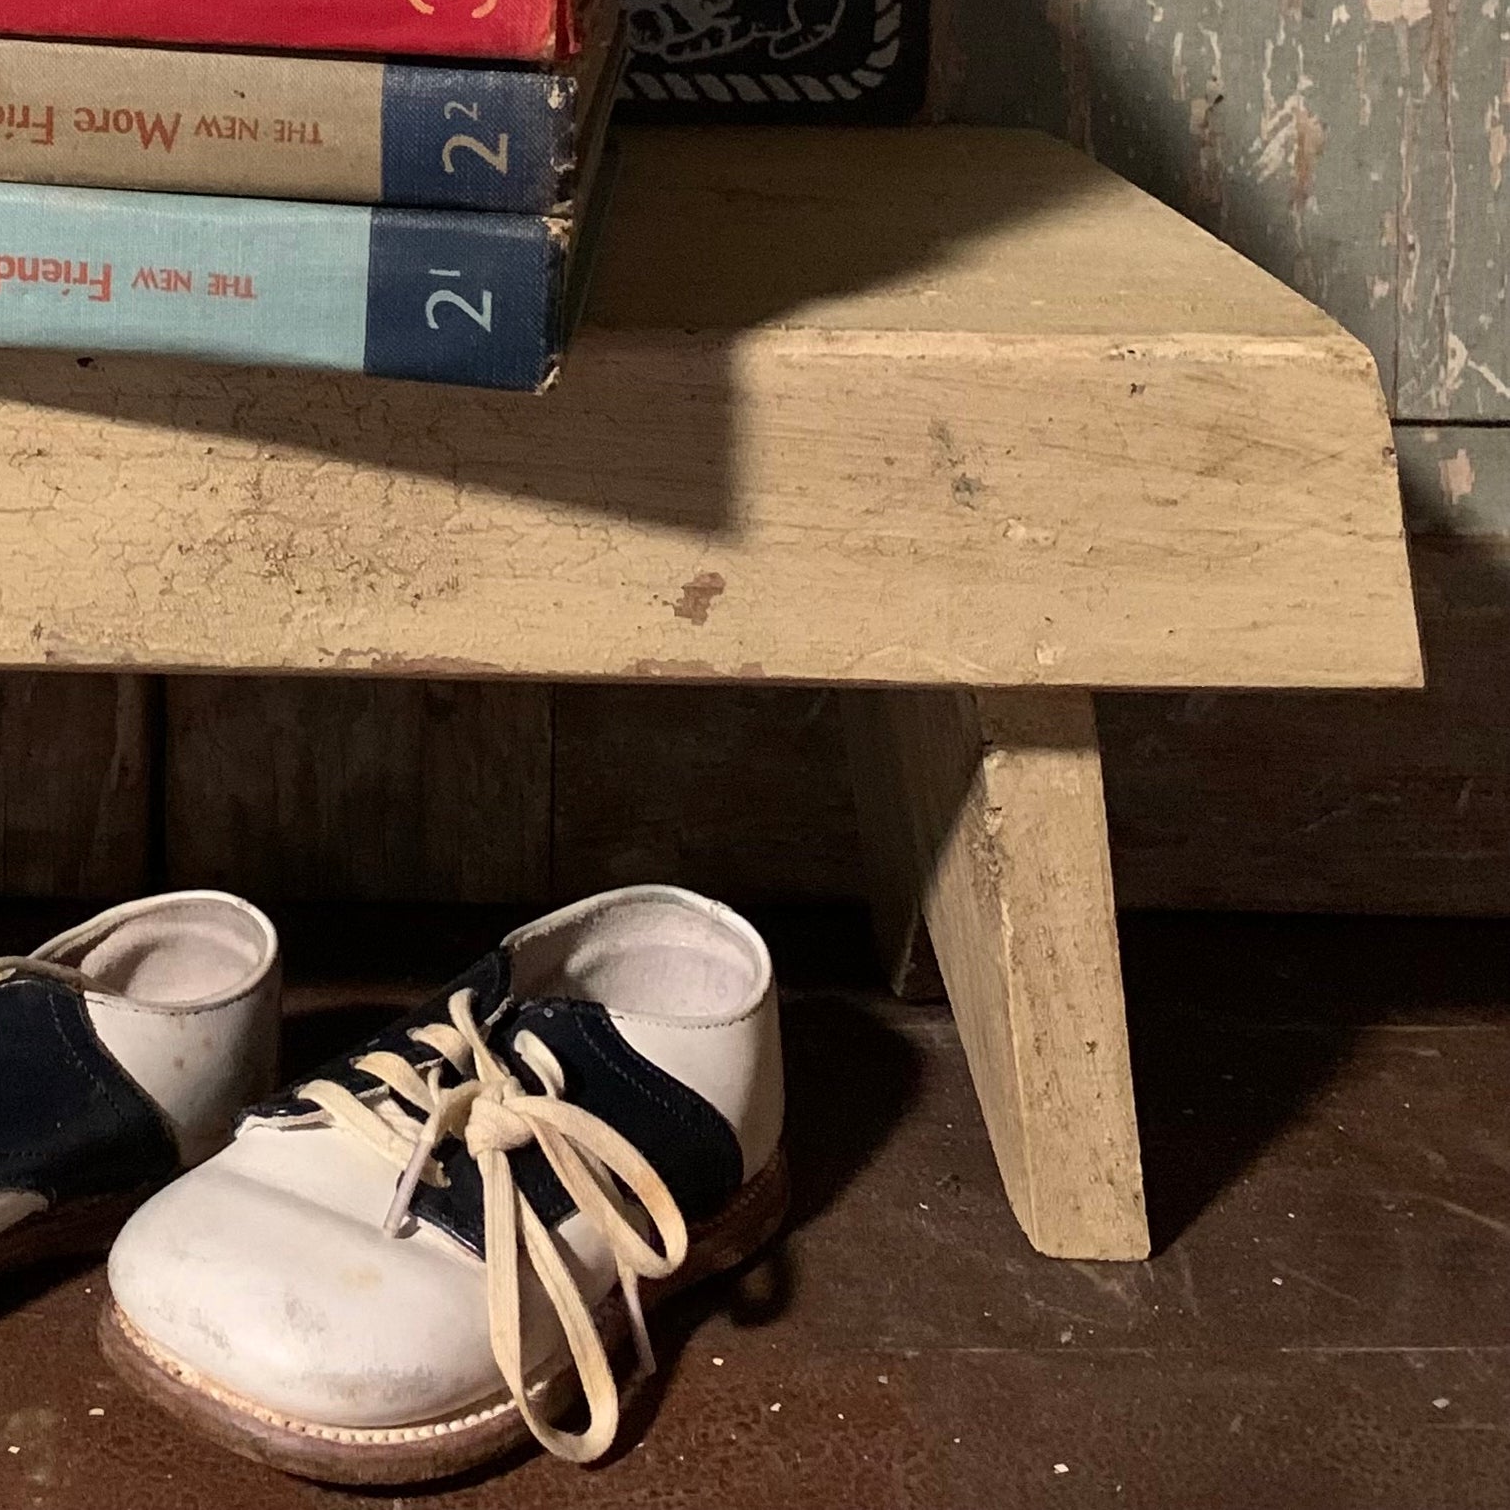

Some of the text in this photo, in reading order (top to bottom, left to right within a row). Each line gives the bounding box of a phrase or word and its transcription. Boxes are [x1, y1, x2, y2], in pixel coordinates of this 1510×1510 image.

[73, 106, 180, 153] More
[194, 116, 260, 141] NEW
[274, 120, 324, 146] THE
[131, 267, 192, 293] NEW
[208, 273, 258, 299] THE
